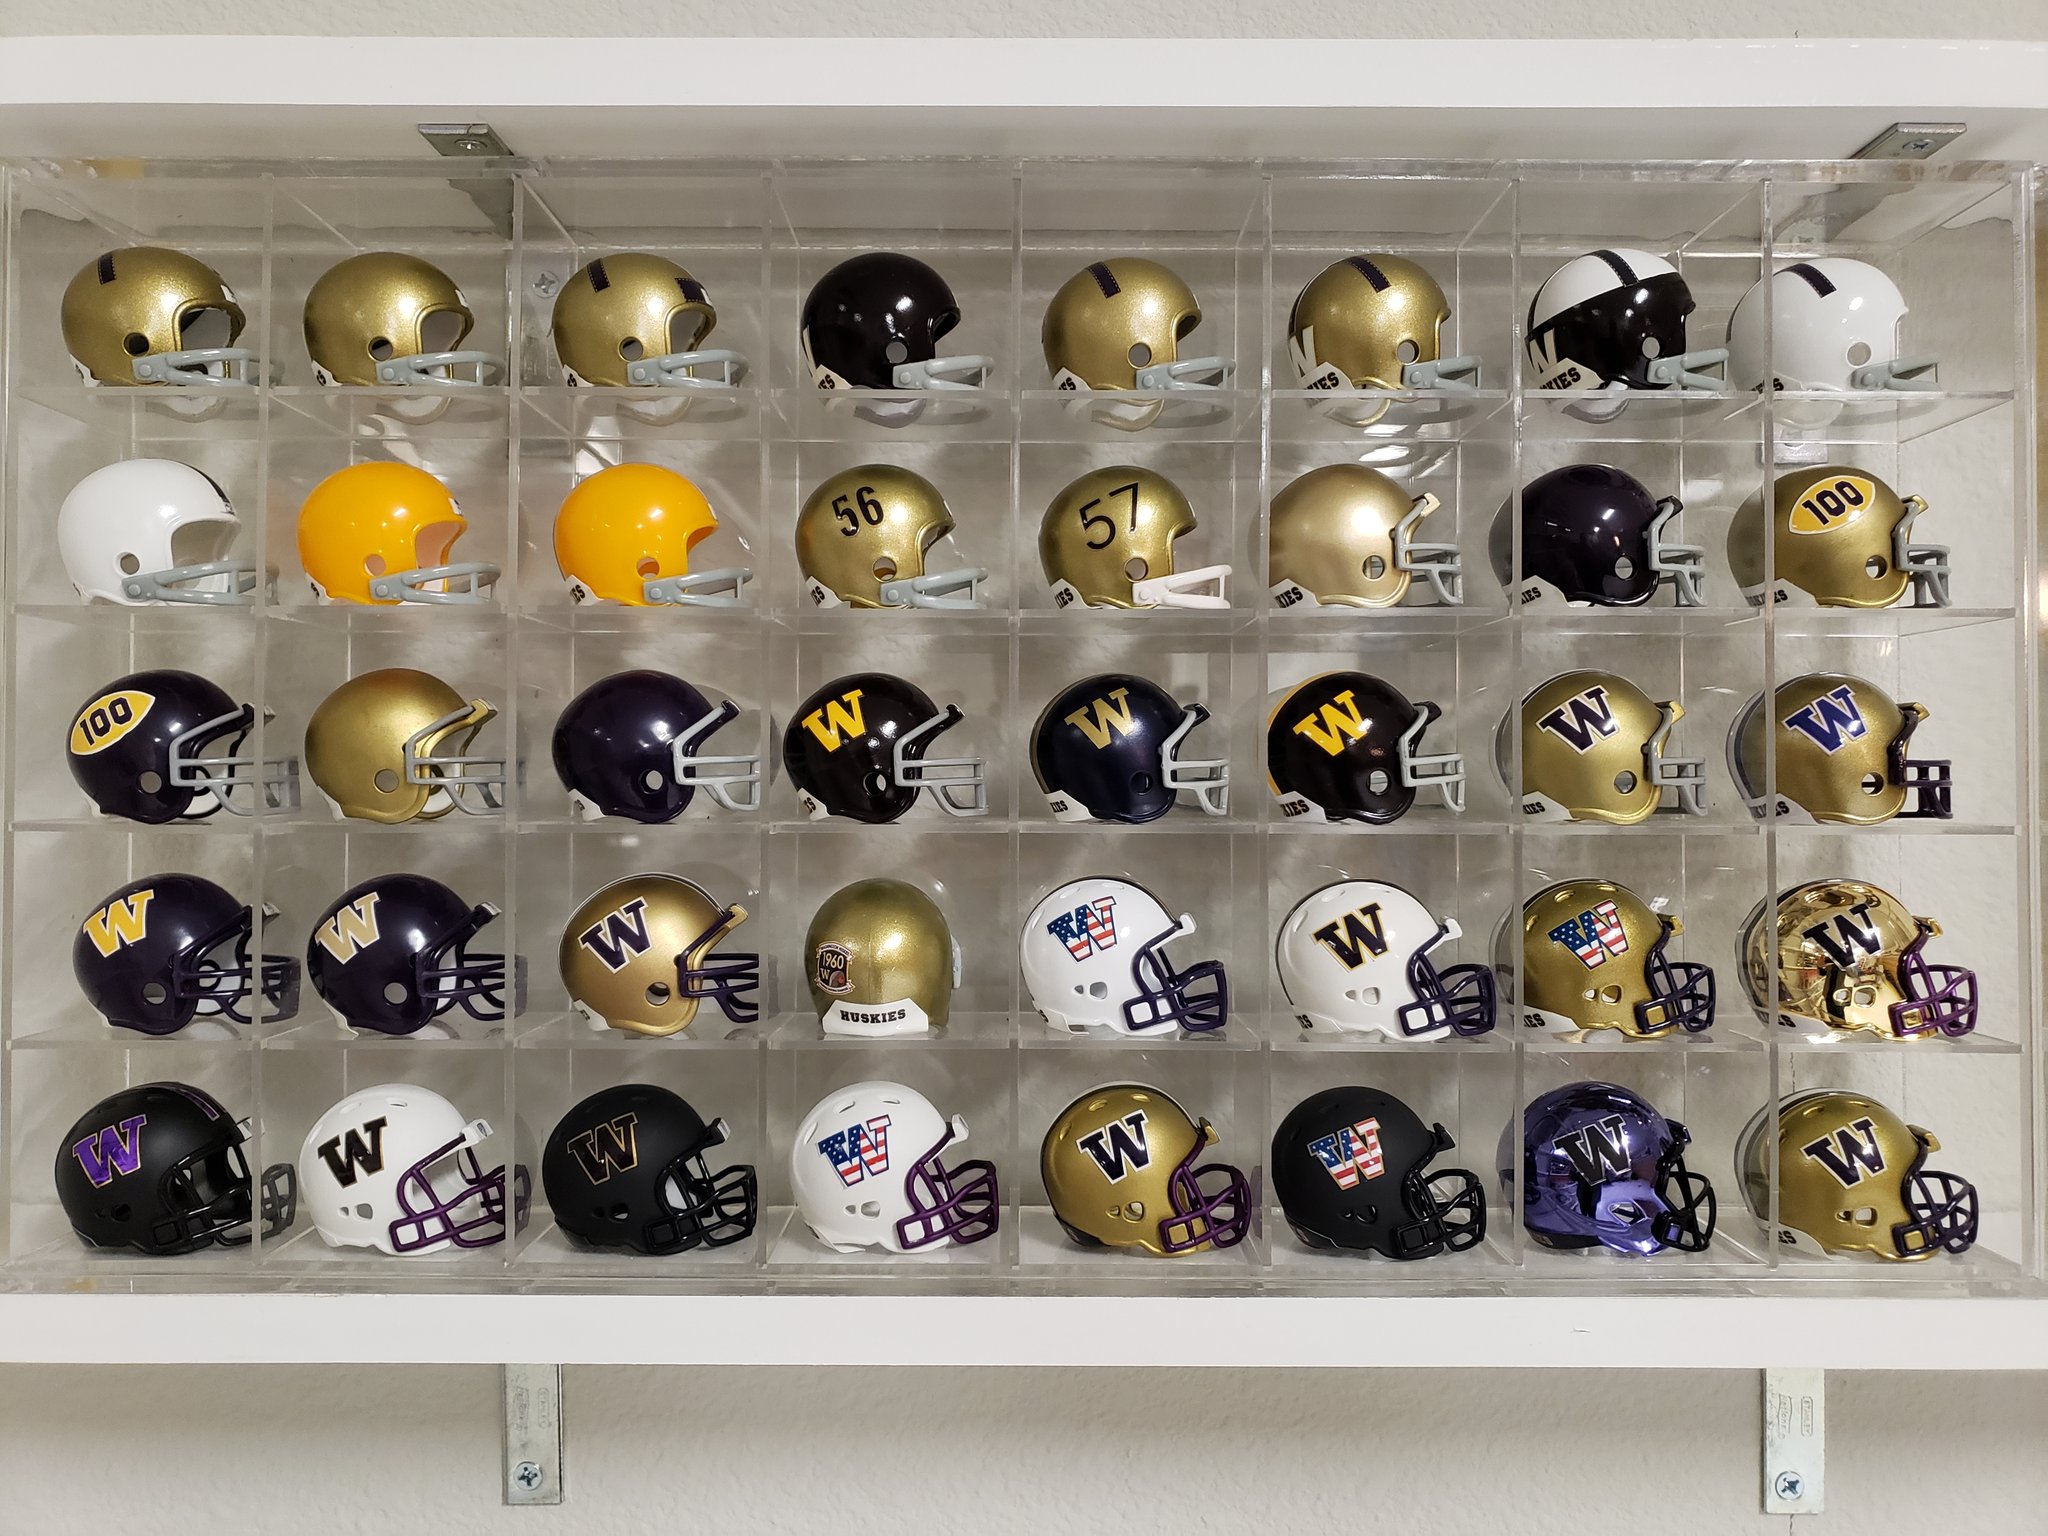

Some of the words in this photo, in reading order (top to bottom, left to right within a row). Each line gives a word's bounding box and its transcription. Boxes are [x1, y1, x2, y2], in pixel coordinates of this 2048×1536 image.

[832, 486, 884, 537] 56
[1079, 482, 1139, 550] 57
[1802, 480, 1863, 526] 100
[81, 696, 133, 746] 100
[802, 689, 866, 753] W
[1064, 687, 1133, 750] W
[1294, 689, 1368, 757] W
[1536, 684, 1619, 756] W
[1781, 683, 1867, 756] W
[83, 888, 154, 958] W
[314, 891, 380, 965] W
[577, 896, 652, 974] W
[1047, 895, 1117, 963] W
[1312, 902, 1389, 973] W
[1546, 899, 1628, 970] W
[1801, 903, 1881, 969] W
[822, 952, 844, 969] 1960
[840, 1008, 906, 1024] HUSKIES
[73, 1114, 147, 1189] W
[317, 1116, 388, 1189] W
[567, 1112, 638, 1185] W
[817, 1114, 892, 1187] W
[1076, 1108, 1149, 1185] W
[1307, 1116, 1384, 1190] W
[1551, 1113, 1631, 1186] W
[1800, 1115, 1887, 1190] W
